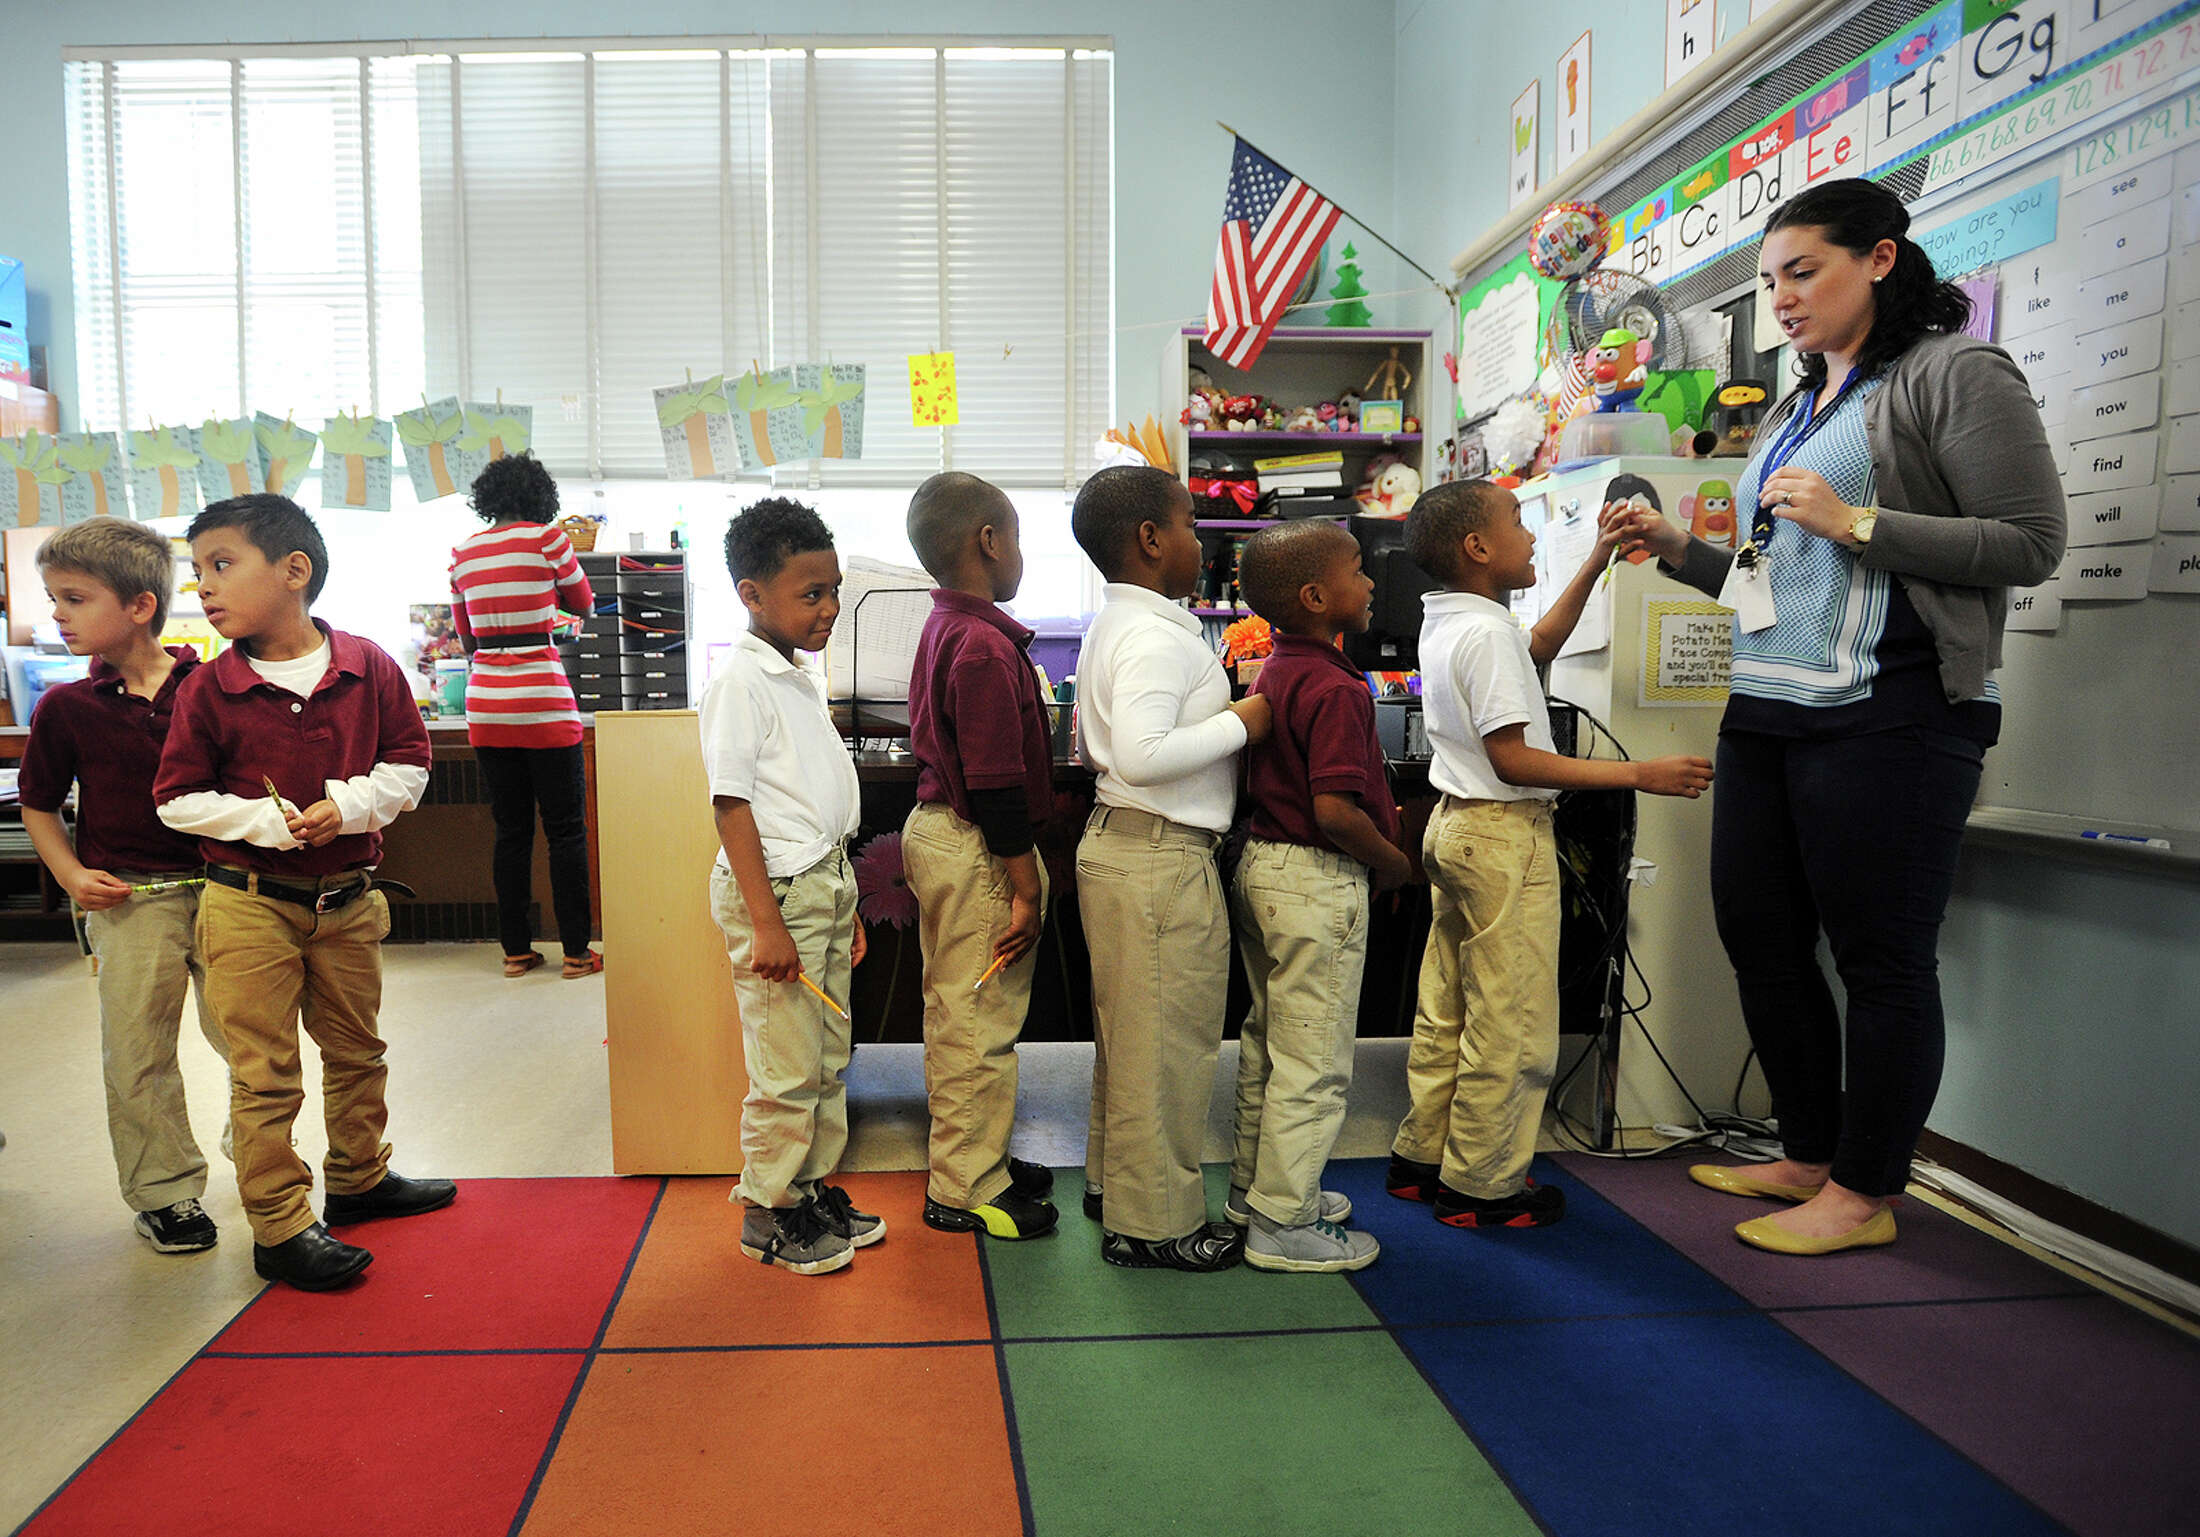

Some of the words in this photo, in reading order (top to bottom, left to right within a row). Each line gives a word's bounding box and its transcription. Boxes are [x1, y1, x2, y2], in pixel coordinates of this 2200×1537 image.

[1682, 31, 1694, 60] h
[1631, 228, 1662, 275] Bb
[1680, 203, 1718, 248] Cc
[1739, 152, 1782, 221] Dd
[1807, 121, 1852, 183] Ee
[1886, 54, 1946, 138] Ff
[1973, 10, 2056, 84] Gg
[1516, 172, 1528, 192] w
[2111, 176, 2138, 195] see
[1924, 228, 1959, 250] How
[1967, 210, 1999, 235] are
[2009, 191, 2042, 226] you
[1538, 213, 1585, 255] Happy
[1940, 228, 2005, 273] doing?
[2116, 237, 2126, 249] a
[2028, 296, 2051, 312] like
[2106, 289, 2129, 307] me
[2023, 348, 2045, 365] the
[2100, 345, 2128, 366] you
[2095, 400, 2127, 417] now
[2092, 455, 2123, 473] find
[2095, 506, 2121, 523] will
[2080, 563, 2123, 579] make
[2013, 598, 2034, 611] off
[1688, 623, 1713, 633] Make
[1672, 635, 1710, 645] Potato
[1672, 647, 1697, 657] Face
[1667, 660, 1685, 670] and
[1688, 660, 1715, 672] you'll
[1673, 672, 1709, 684] special
